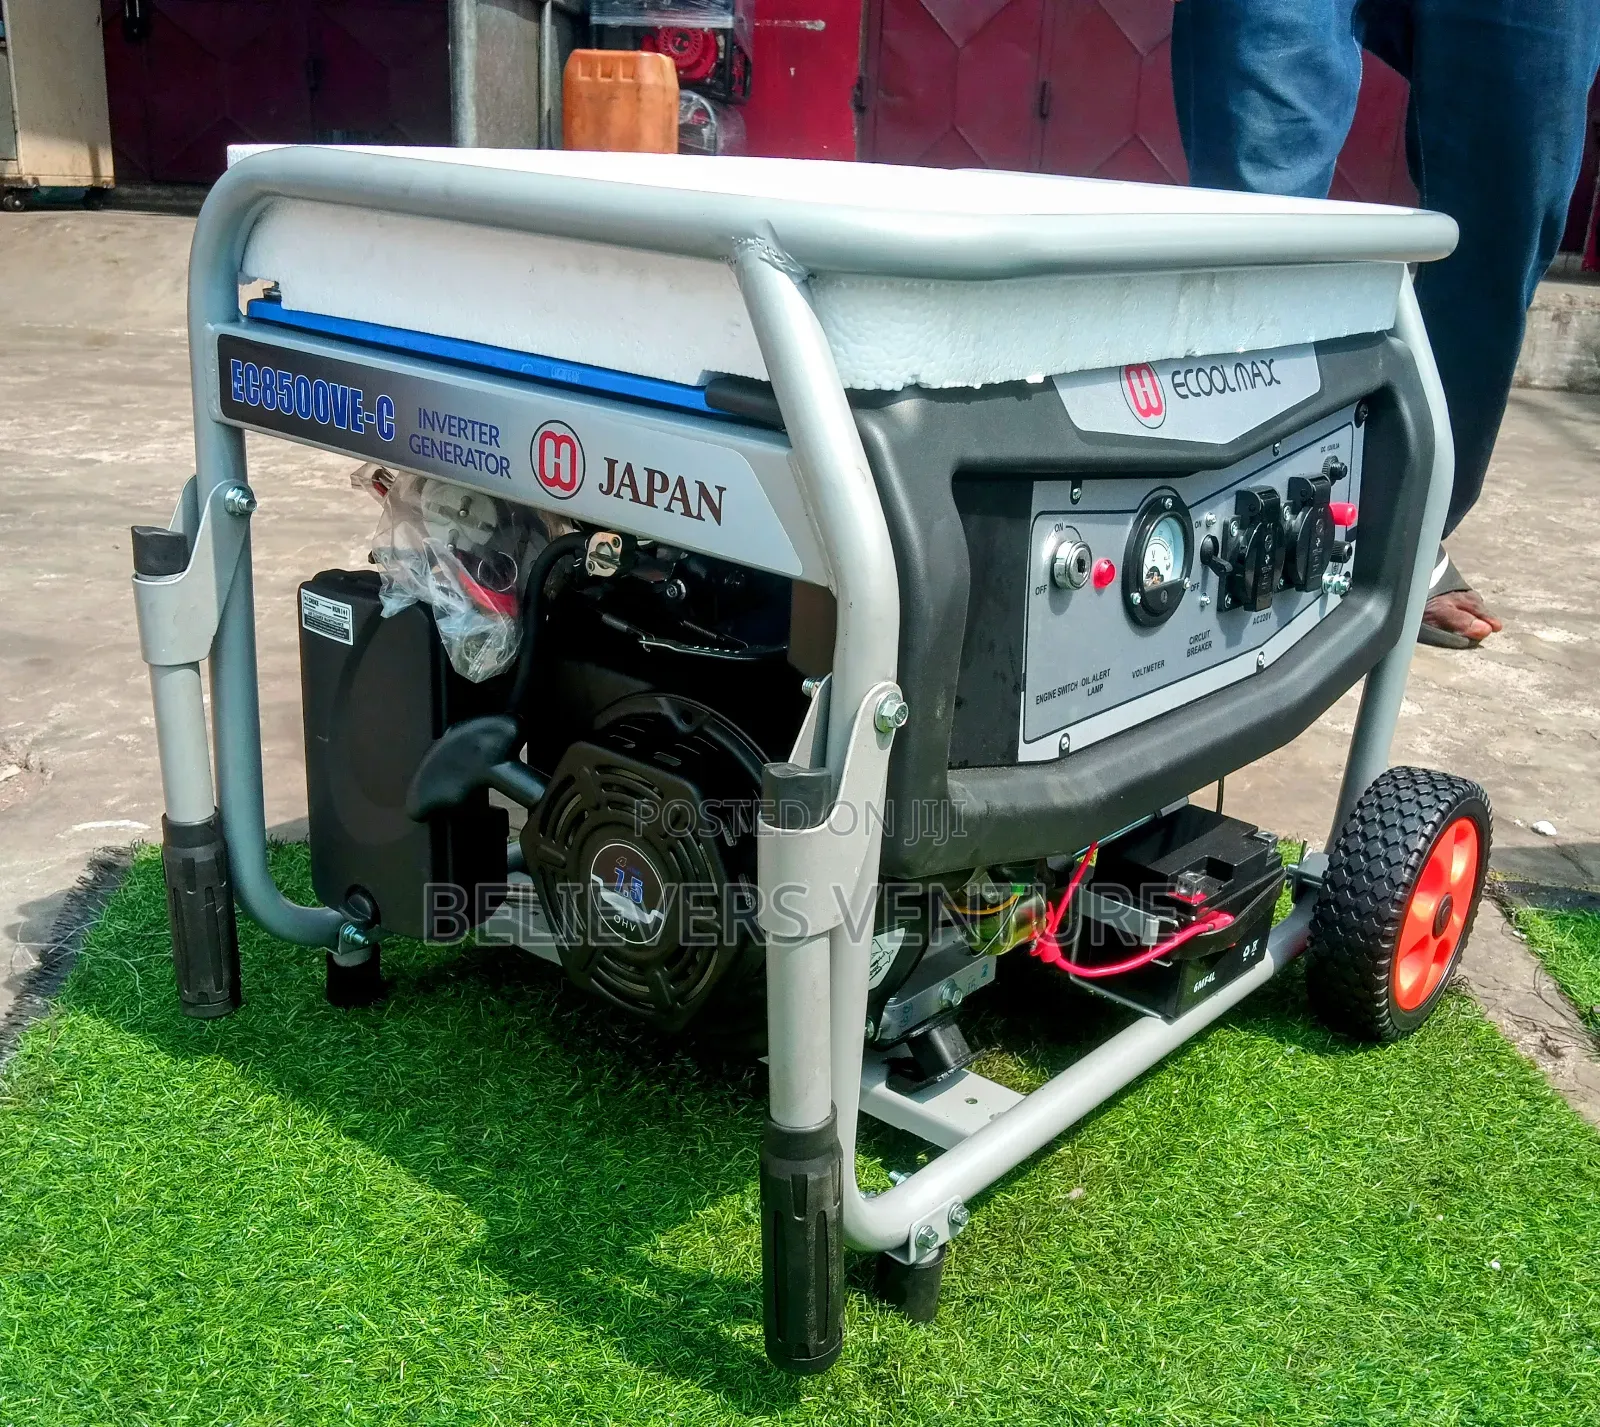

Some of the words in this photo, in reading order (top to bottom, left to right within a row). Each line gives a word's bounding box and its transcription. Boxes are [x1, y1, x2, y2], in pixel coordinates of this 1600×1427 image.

[1171, 358, 1281, 400] ECOOLMAX
[230, 357, 396, 443] EC8500VE-C
[417, 406, 501, 447] INVERTER
[408, 433, 512, 481] GENERATOR
[598, 457, 727, 527] JAPAN
[1054, 522, 1064, 533] ON
[1194, 520, 1202, 529] ON
[1034, 584, 1048, 596] OFF
[1190, 582, 1200, 592] OFF
[1252, 611, 1272, 626] AC220V
[1188, 629, 1211, 645] CIRCUIT
[1186, 641, 1213, 658] BREAKER
[1081, 677, 1091, 687] OIL
[1091, 668, 1111, 683] ALERT
[1131, 659, 1165, 679] VOLTMETER
[1035, 689, 1057, 705] ENGINE
[1057, 681, 1079, 697] SWITCH
[1087, 683, 1104, 697] LAMP
[613, 914, 637, 932] OHV
